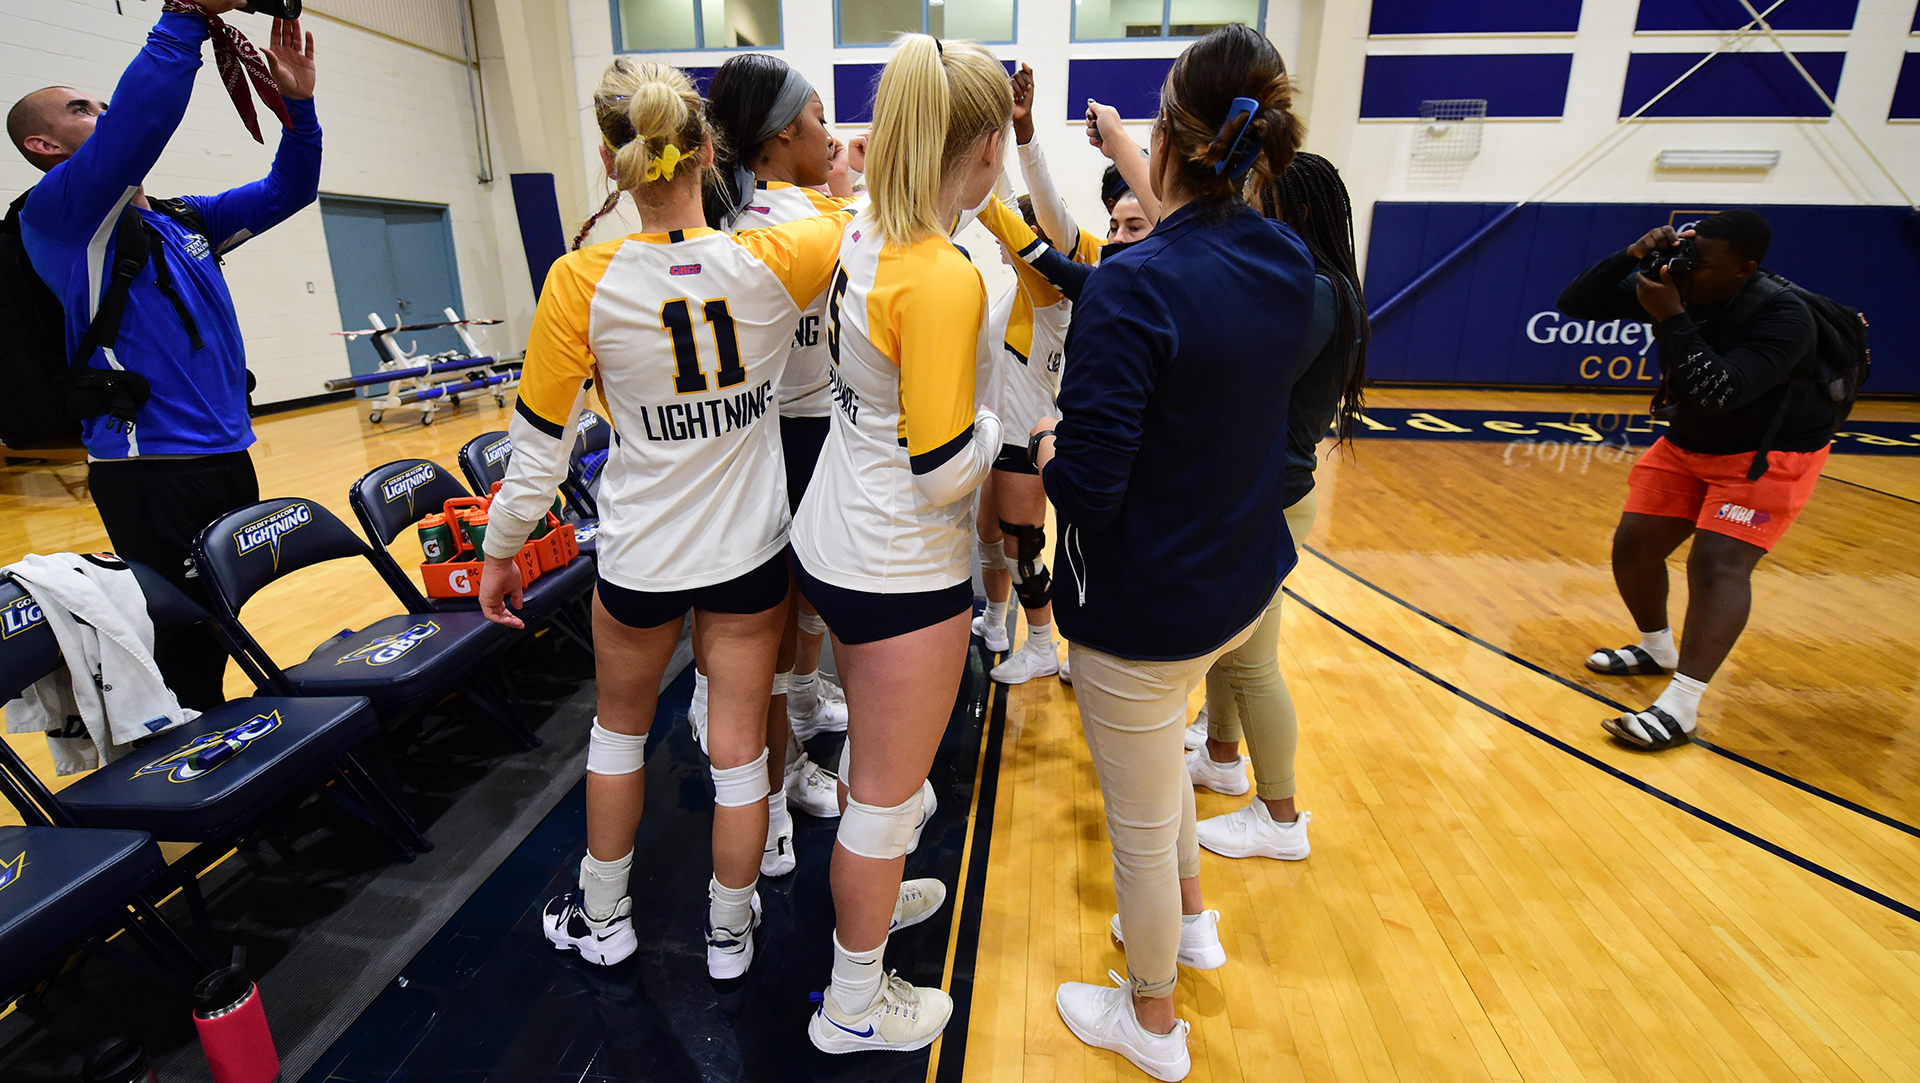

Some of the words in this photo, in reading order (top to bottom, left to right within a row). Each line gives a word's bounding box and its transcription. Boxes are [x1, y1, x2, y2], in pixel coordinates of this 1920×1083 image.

[670, 264, 701, 275] CACC
[826, 256, 850, 368] 5
[659, 297, 747, 395] 11
[1580, 355, 1665, 380] COL
[640, 379, 773, 441] LIGHTNING
[383, 465, 434, 501] LIGHTNING
[237, 505, 309, 553] LIGHTNING
[244, 507, 295, 534] GOLDEY-BEACOM
[1726, 504, 1756, 524] NBA
[373, 626, 435, 663] GBC
